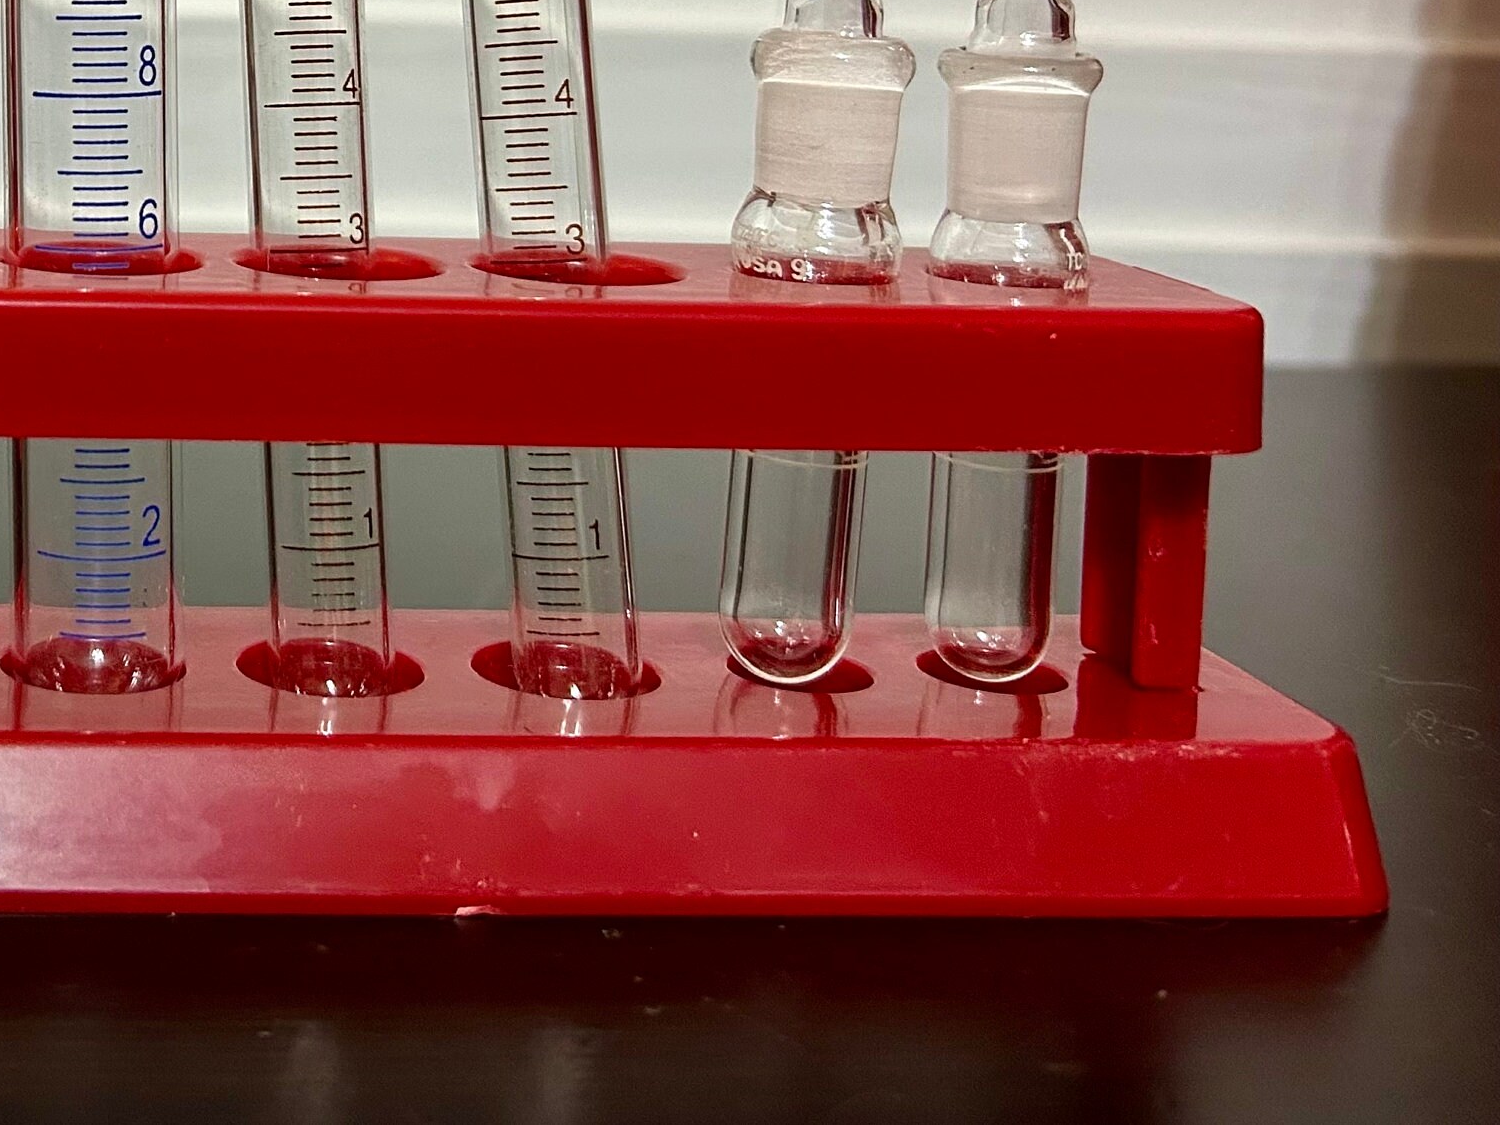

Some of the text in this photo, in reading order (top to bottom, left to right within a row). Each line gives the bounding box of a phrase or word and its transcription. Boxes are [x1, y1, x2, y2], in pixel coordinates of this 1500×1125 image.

[138, 44, 157, 86] 8
[341, 68, 360, 99] 4
[554, 78, 575, 109] 4
[137, 198, 159, 239] 6
[348, 212, 365, 245] 3
[565, 223, 586, 255] 3
[141, 505, 162, 547] 2
[362, 507, 374, 539] 1
[588, 518, 601, 550] 1
